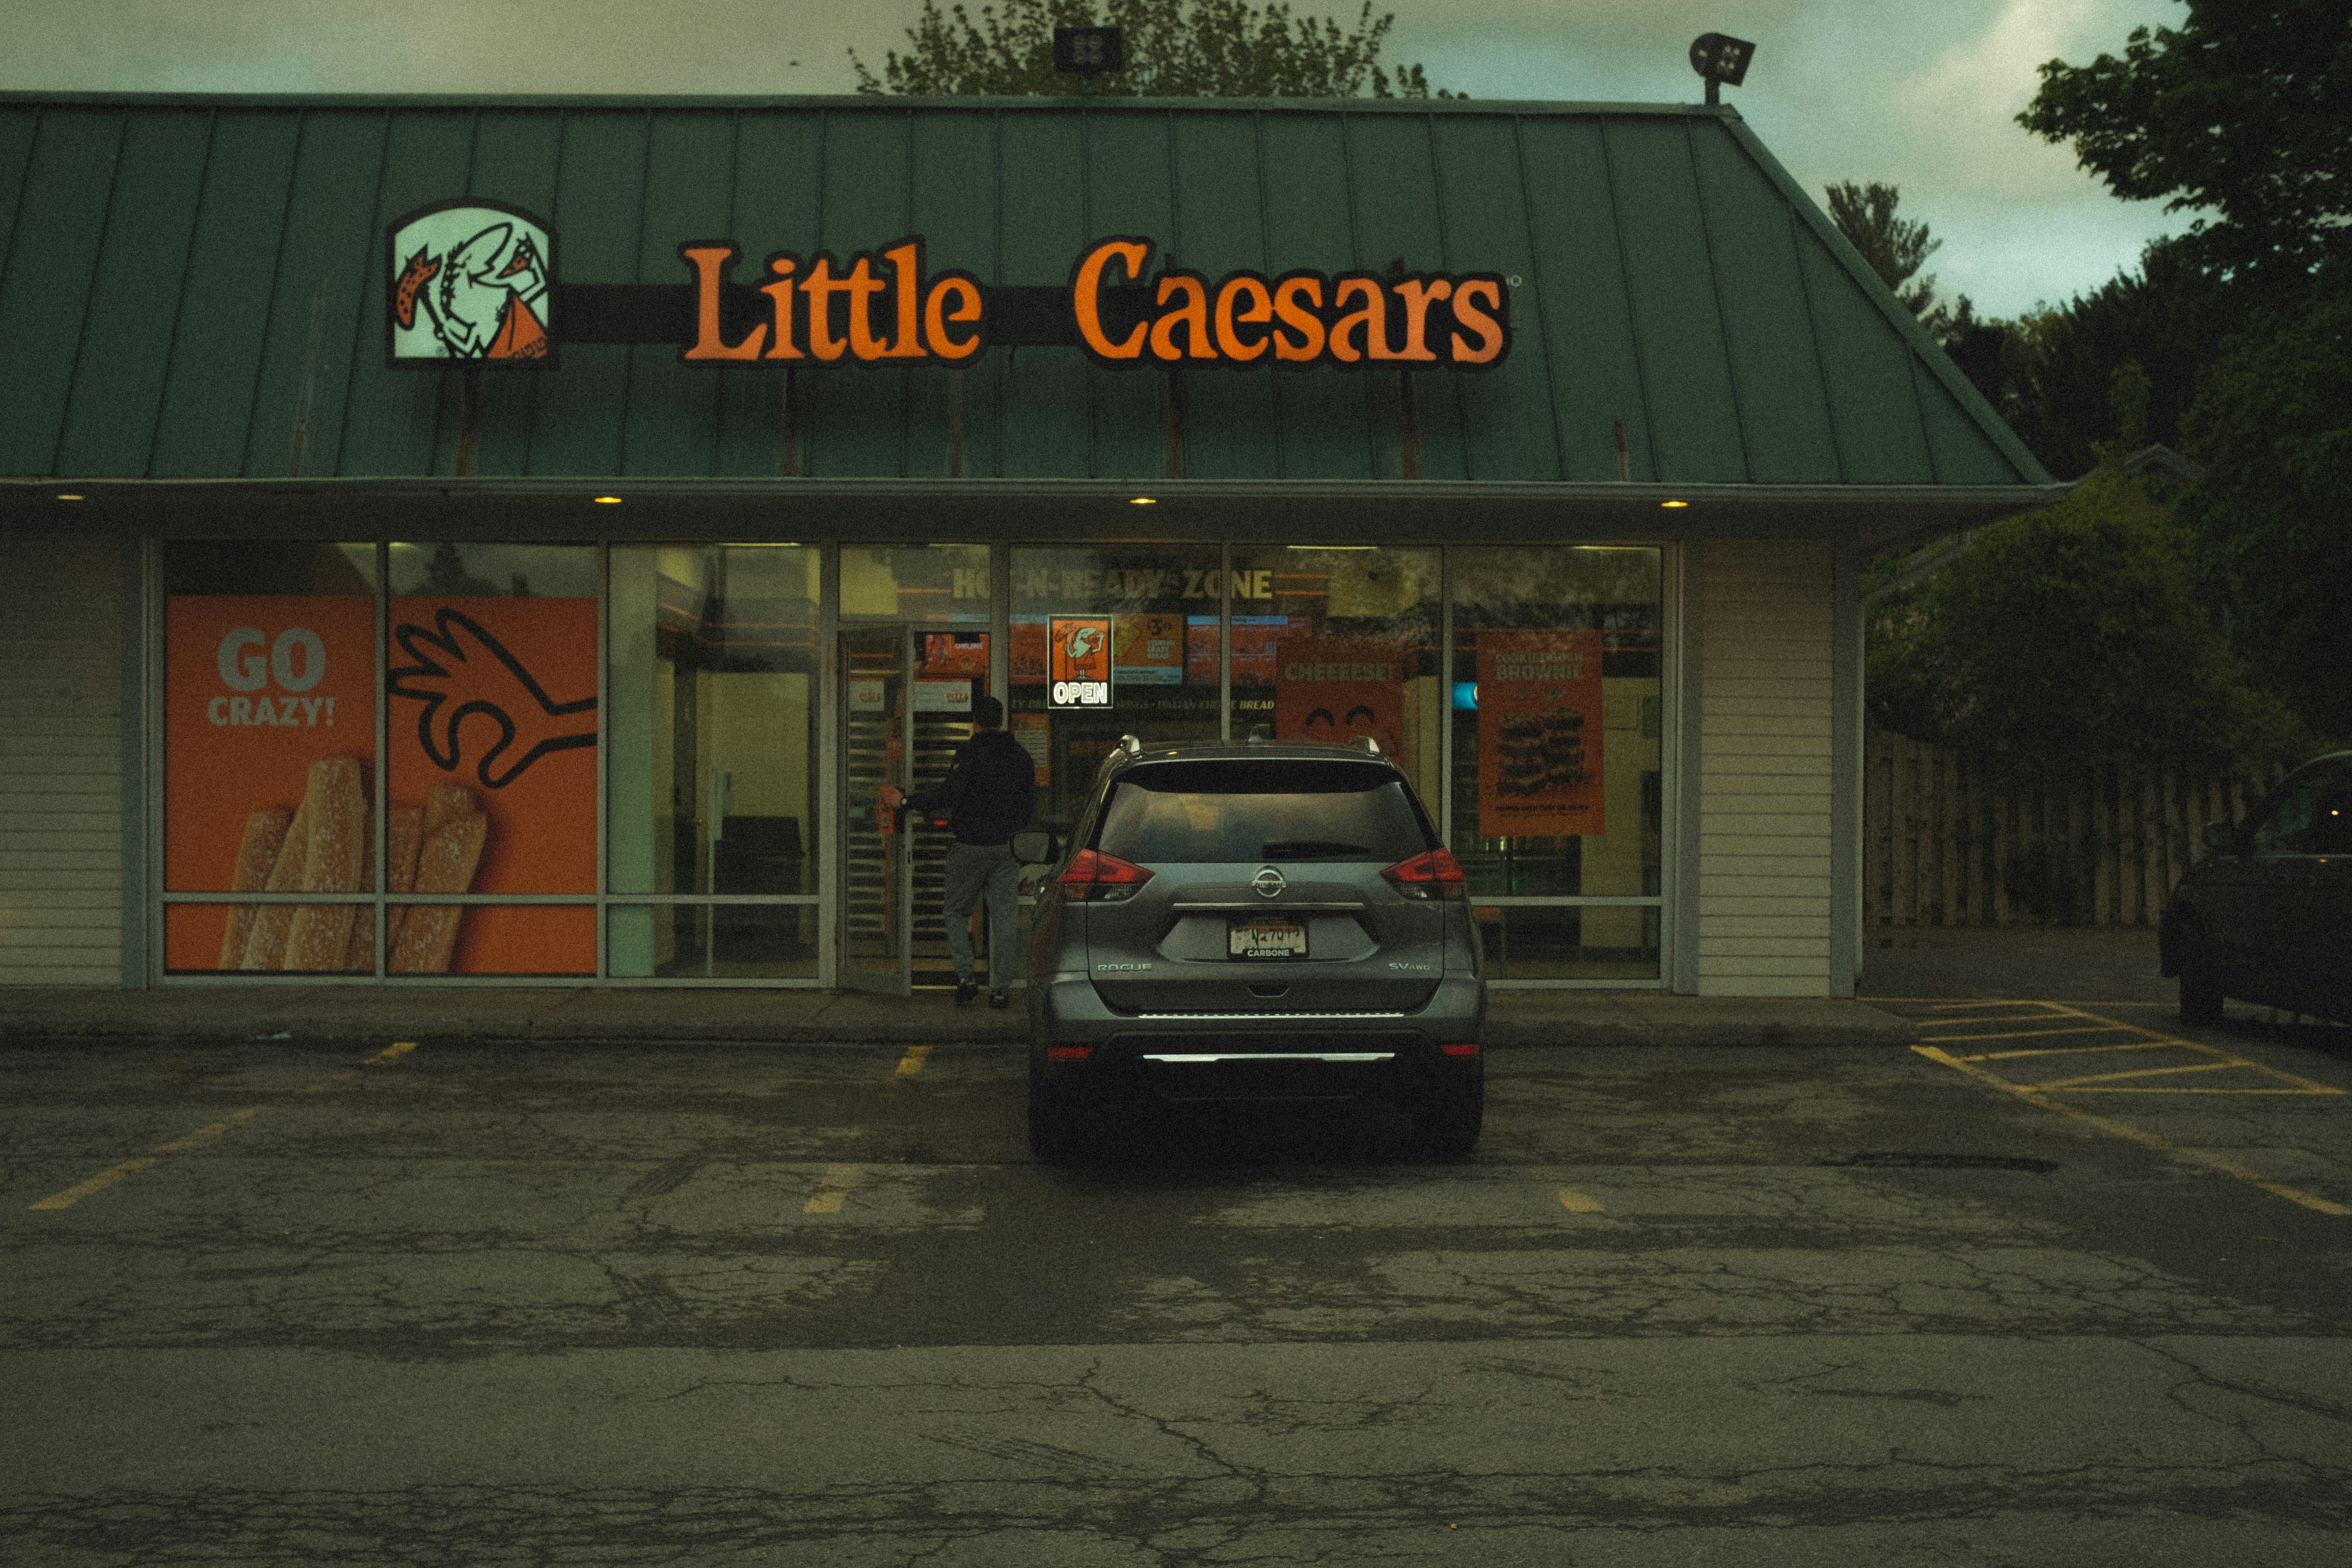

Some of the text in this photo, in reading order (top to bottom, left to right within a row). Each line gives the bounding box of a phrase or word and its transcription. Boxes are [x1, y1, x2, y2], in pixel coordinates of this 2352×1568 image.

[684, 241, 1504, 362] Little Caesars
[1182, 569, 1273, 600] ZONE
[217, 627, 326, 692] GO
[1284, 662, 1395, 682] CHEEEESE!
[1496, 664, 1583, 681] BROWNIE
[1053, 682, 1107, 705] OPEN
[1239, 699, 1276, 710] BREAD
[207, 697, 335, 726] CRAZY!
[1097, 963, 1152, 971] ROGUE
